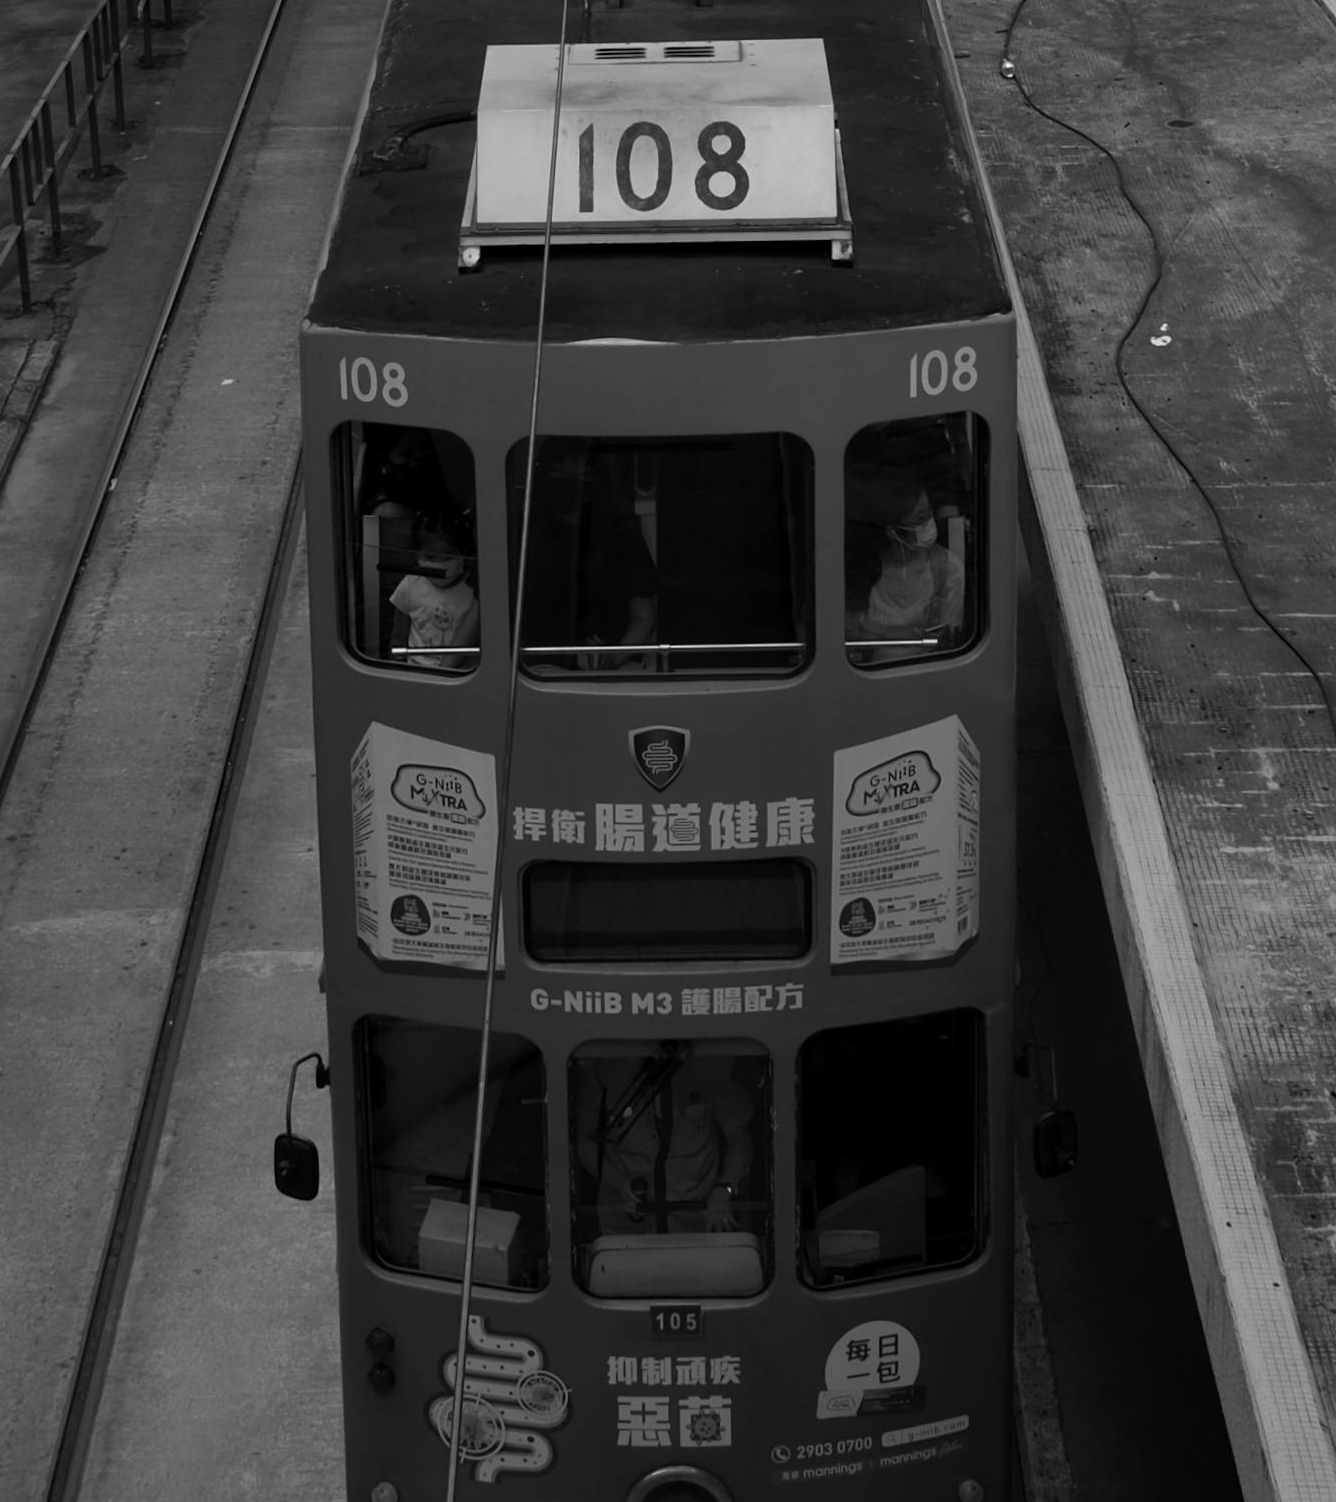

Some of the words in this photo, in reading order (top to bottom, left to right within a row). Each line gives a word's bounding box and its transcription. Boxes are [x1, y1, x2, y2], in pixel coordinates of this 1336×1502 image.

[578, 120, 751, 214] 108
[339, 357, 409, 408] 108
[908, 346, 980, 400] 108
[513, 796, 817, 853] 捍衛腸道健康
[630, 994, 673, 1015] M3
[681, 982, 805, 1016] 護腸配方
[656, 1312, 698, 1332] 105
[846, 1333, 899, 1362] 每日
[606, 1354, 742, 1387] 抑制頑疾
[846, 1360, 901, 1384] 一包
[616, 1395, 733, 1449] 惡菌
[797, 1442, 833, 1459] 2903
[836, 1436, 873, 1454] 0700
[879, 1447, 937, 1466] mannings
[803, 1462, 863, 1479] mannings
